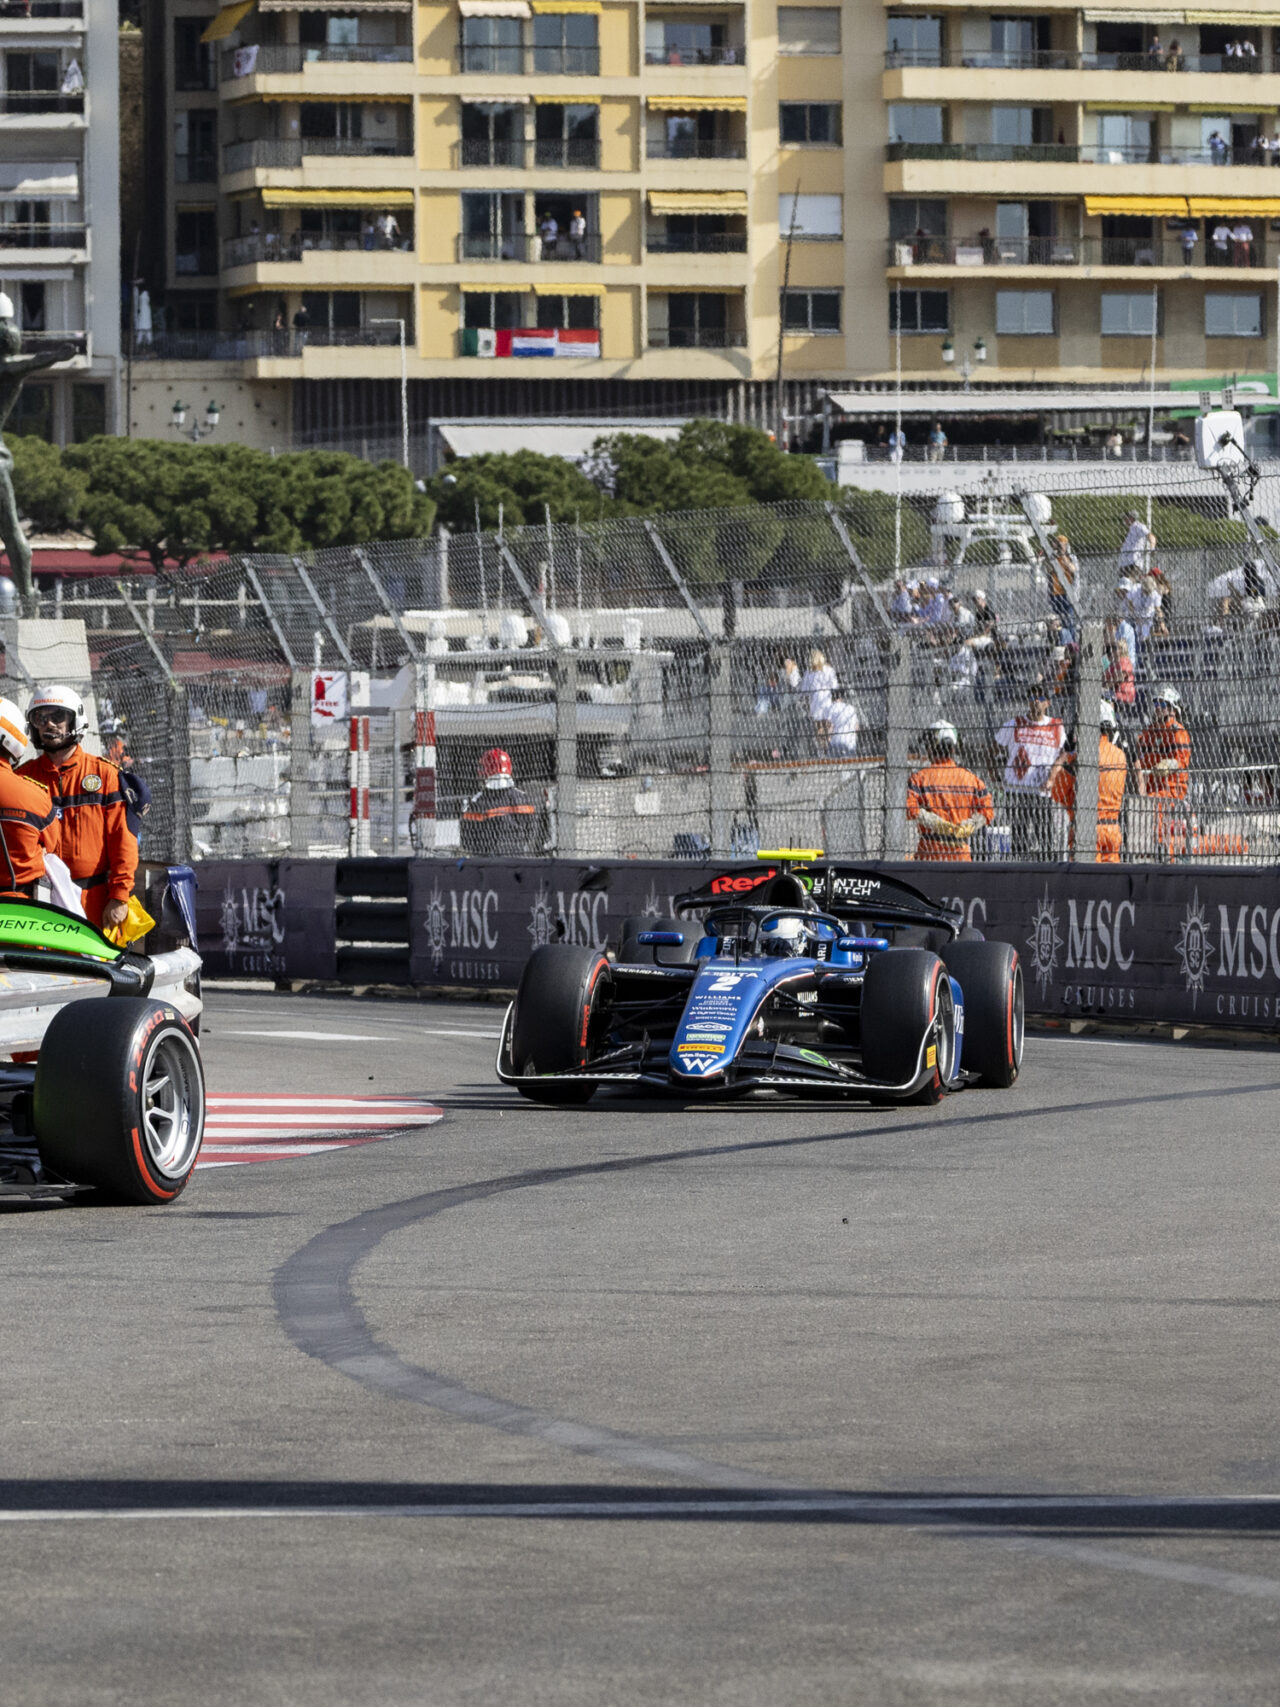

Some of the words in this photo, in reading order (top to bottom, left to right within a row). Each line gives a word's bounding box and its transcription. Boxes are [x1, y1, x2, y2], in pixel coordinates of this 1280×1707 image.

[450, 889, 498, 949] MSC
[557, 891, 608, 951] MSC
[1066, 899, 1135, 970] MSC
[450, 961, 500, 980] CRUISES
[708, 976, 741, 991] 2
[1063, 985, 1135, 1008] CRUISES
